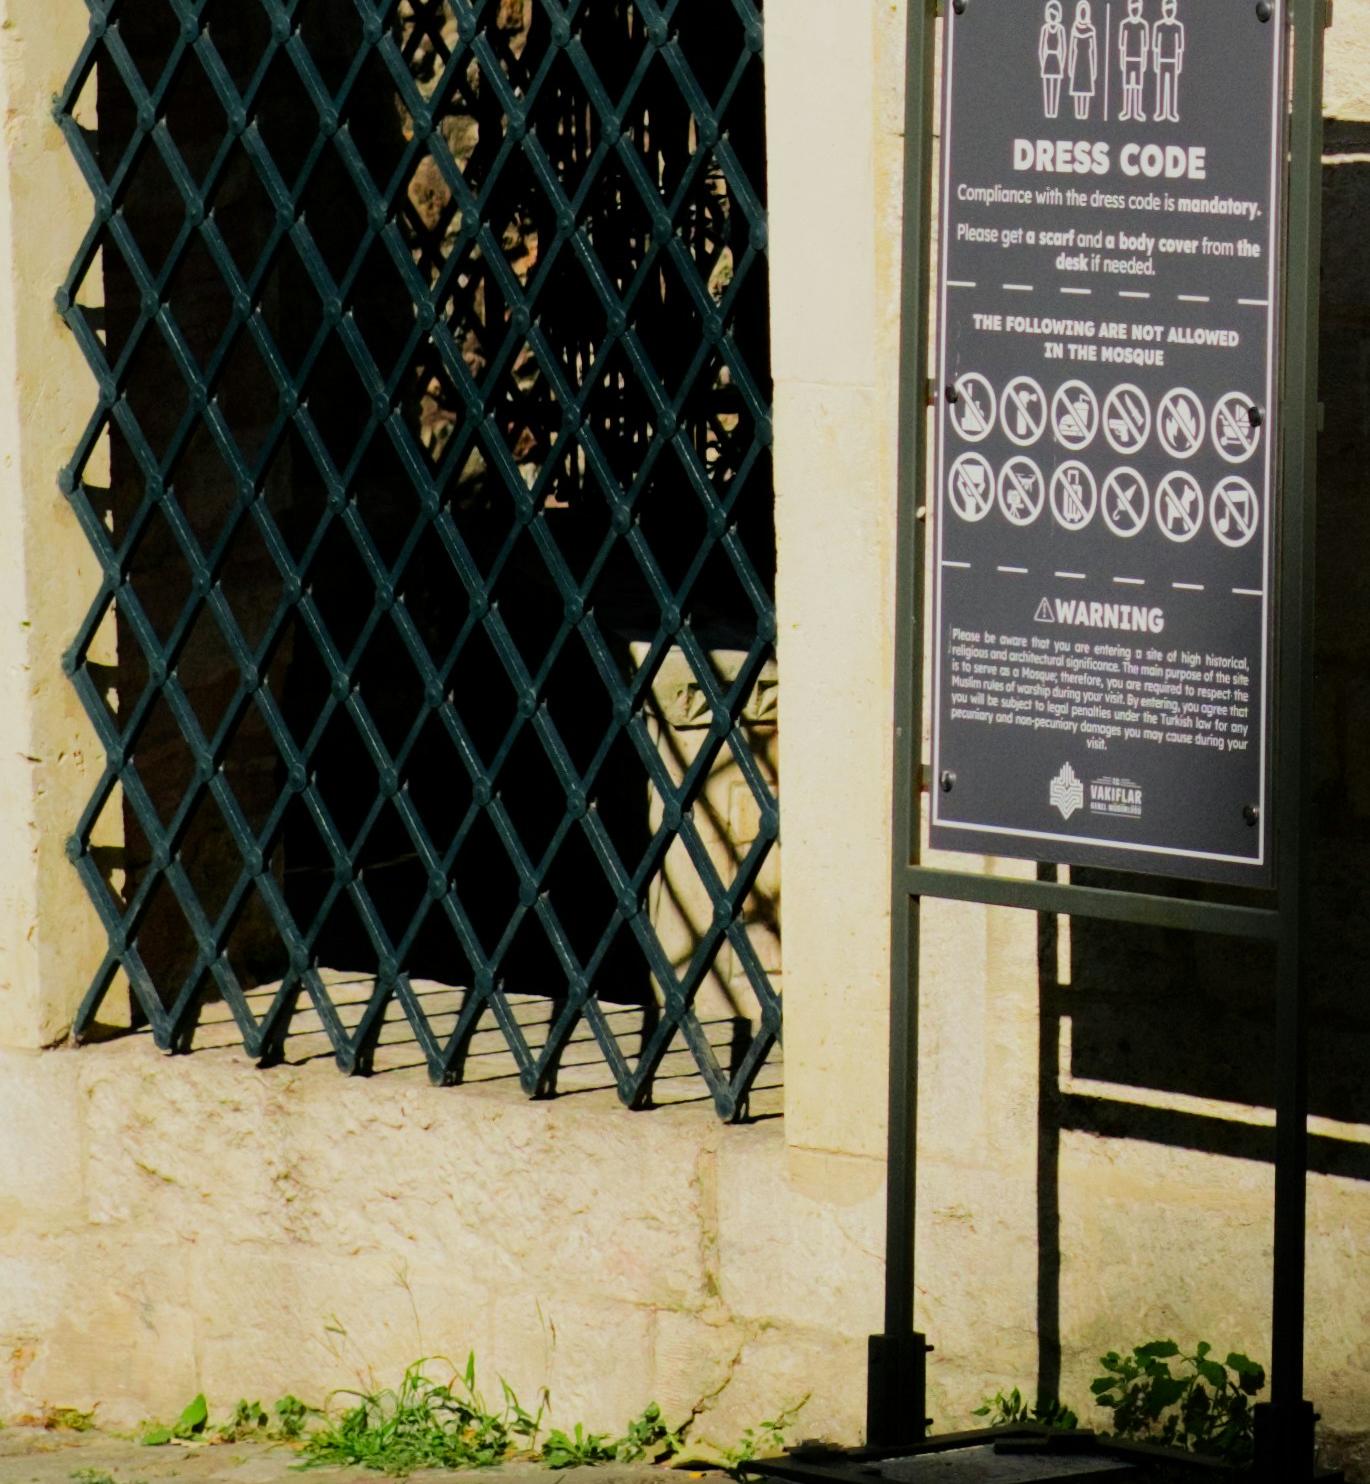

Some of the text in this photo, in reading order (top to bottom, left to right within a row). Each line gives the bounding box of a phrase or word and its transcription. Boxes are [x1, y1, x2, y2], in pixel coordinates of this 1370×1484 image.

[1013, 138, 1206, 180] DRESS CODE
[957, 184, 1262, 221] Compliance with the dress code is mandatory.
[957, 223, 1261, 258] Please get a scarf and a body cover from the
[1056, 252, 1156, 276] desk if needed.
[972, 314, 1239, 347] THE FOLLOWING ARE NOT ALLOWED
[1044, 342, 1164, 367] IN THE MOSQUE
[1055, 598, 1165, 634] WARNING
[952, 627, 1250, 673] Please be aware that you are entering a site of high historical,
[952, 644, 1249, 686] religious and architectural significance. The main purpose of the site
[951, 674, 1249, 718] Muslim rules of worship during your visit. By entering, you agree that
[952, 658, 1249, 703] is to serve as a Mosque; therefore, you are required to respect the
[951, 692, 1249, 737] you will be subject to legal penalties under the Turkish law for any
[951, 708, 1249, 752] pecuniary and non-pecuniary damages you may cause during your
[1087, 736, 1107, 751] visit.
[1090, 784, 1142, 806] VAKIFLAR
